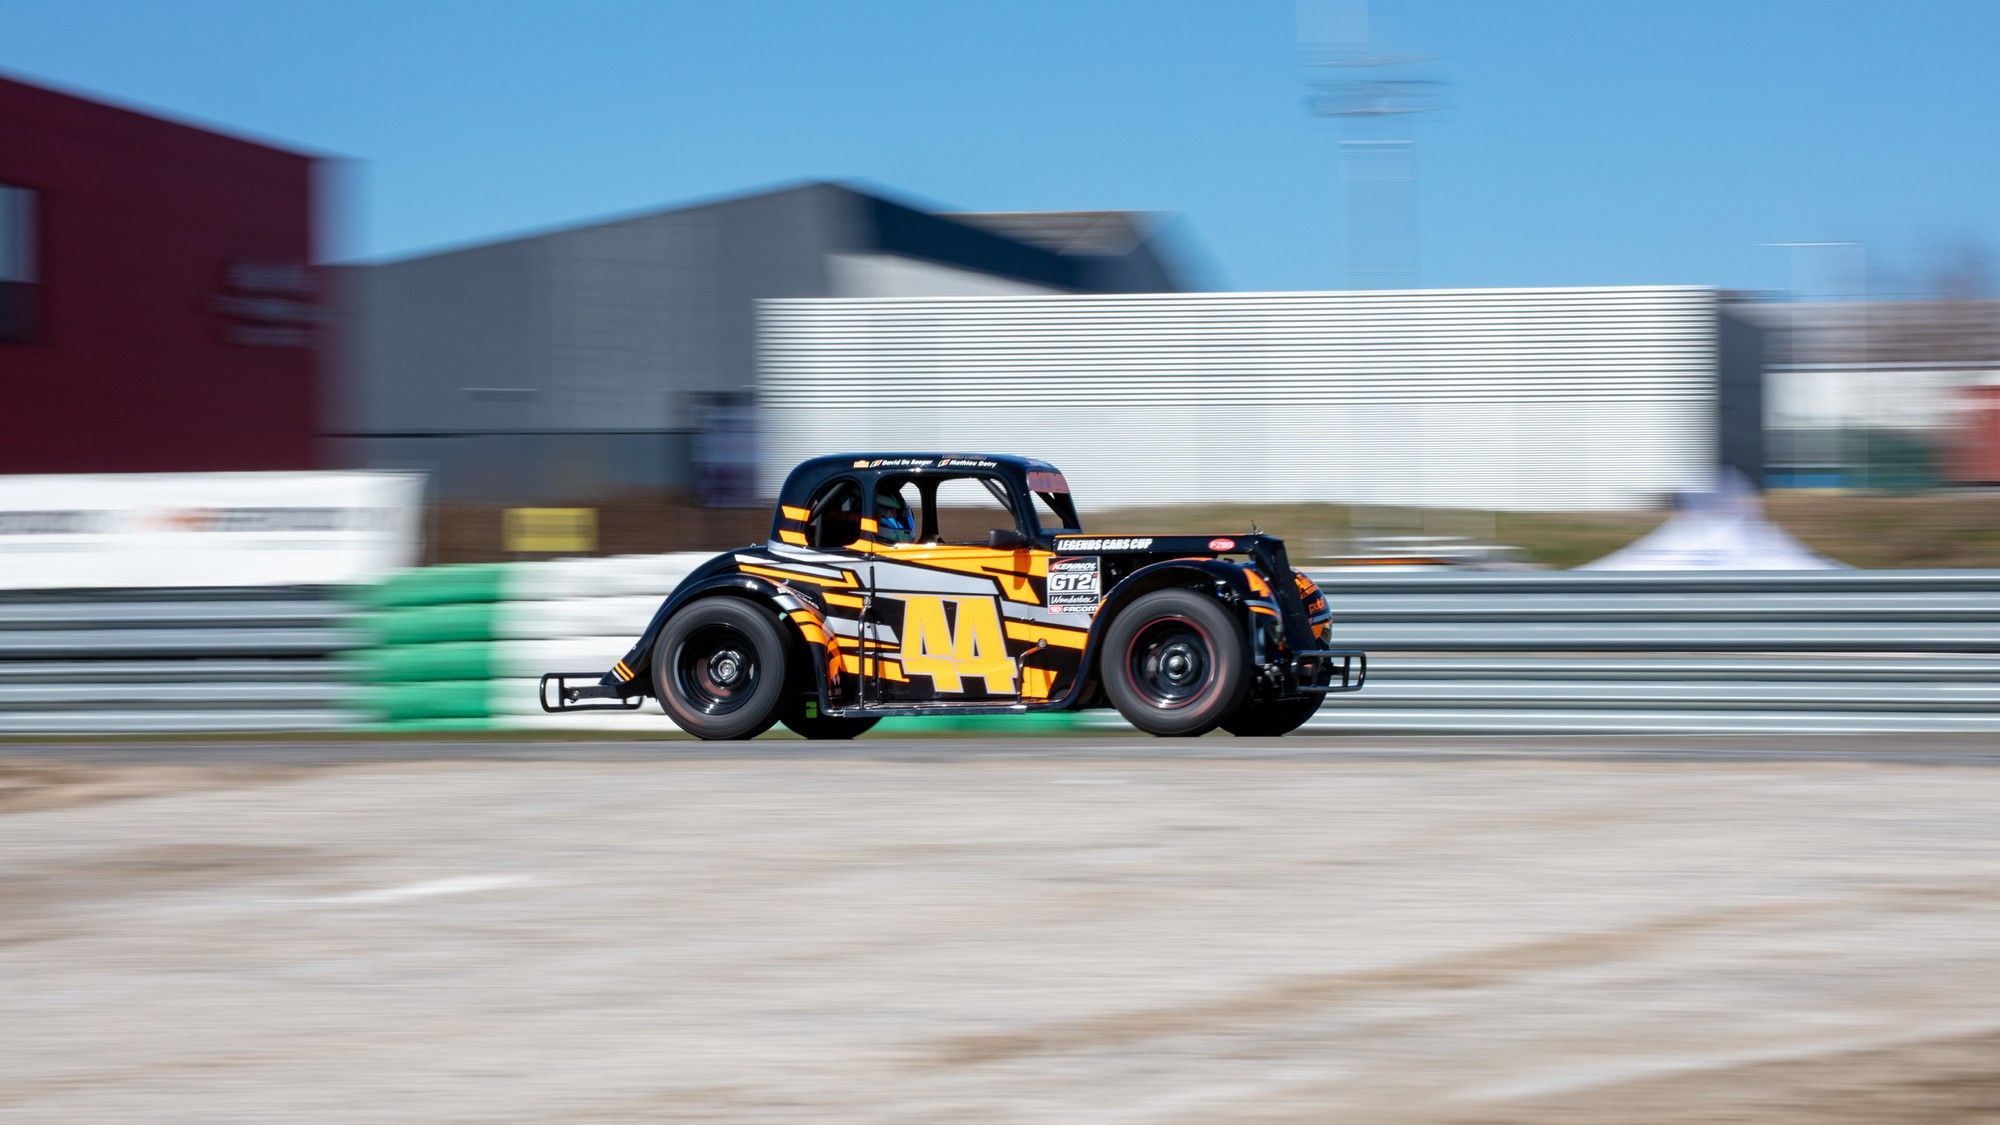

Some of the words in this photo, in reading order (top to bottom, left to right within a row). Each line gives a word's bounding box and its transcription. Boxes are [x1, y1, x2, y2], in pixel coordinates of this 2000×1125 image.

[949, 459, 977, 467] Mathieu
[1057, 539, 1102, 551] LEGENDS
[1102, 539, 1130, 550] CARS
[1130, 538, 1152, 549] CUP
[1053, 562, 1097, 571] KENNOL
[1050, 572, 1098, 591] GT2i
[1063, 605, 1097, 613] FACOM
[900, 594, 1018, 695] 44
